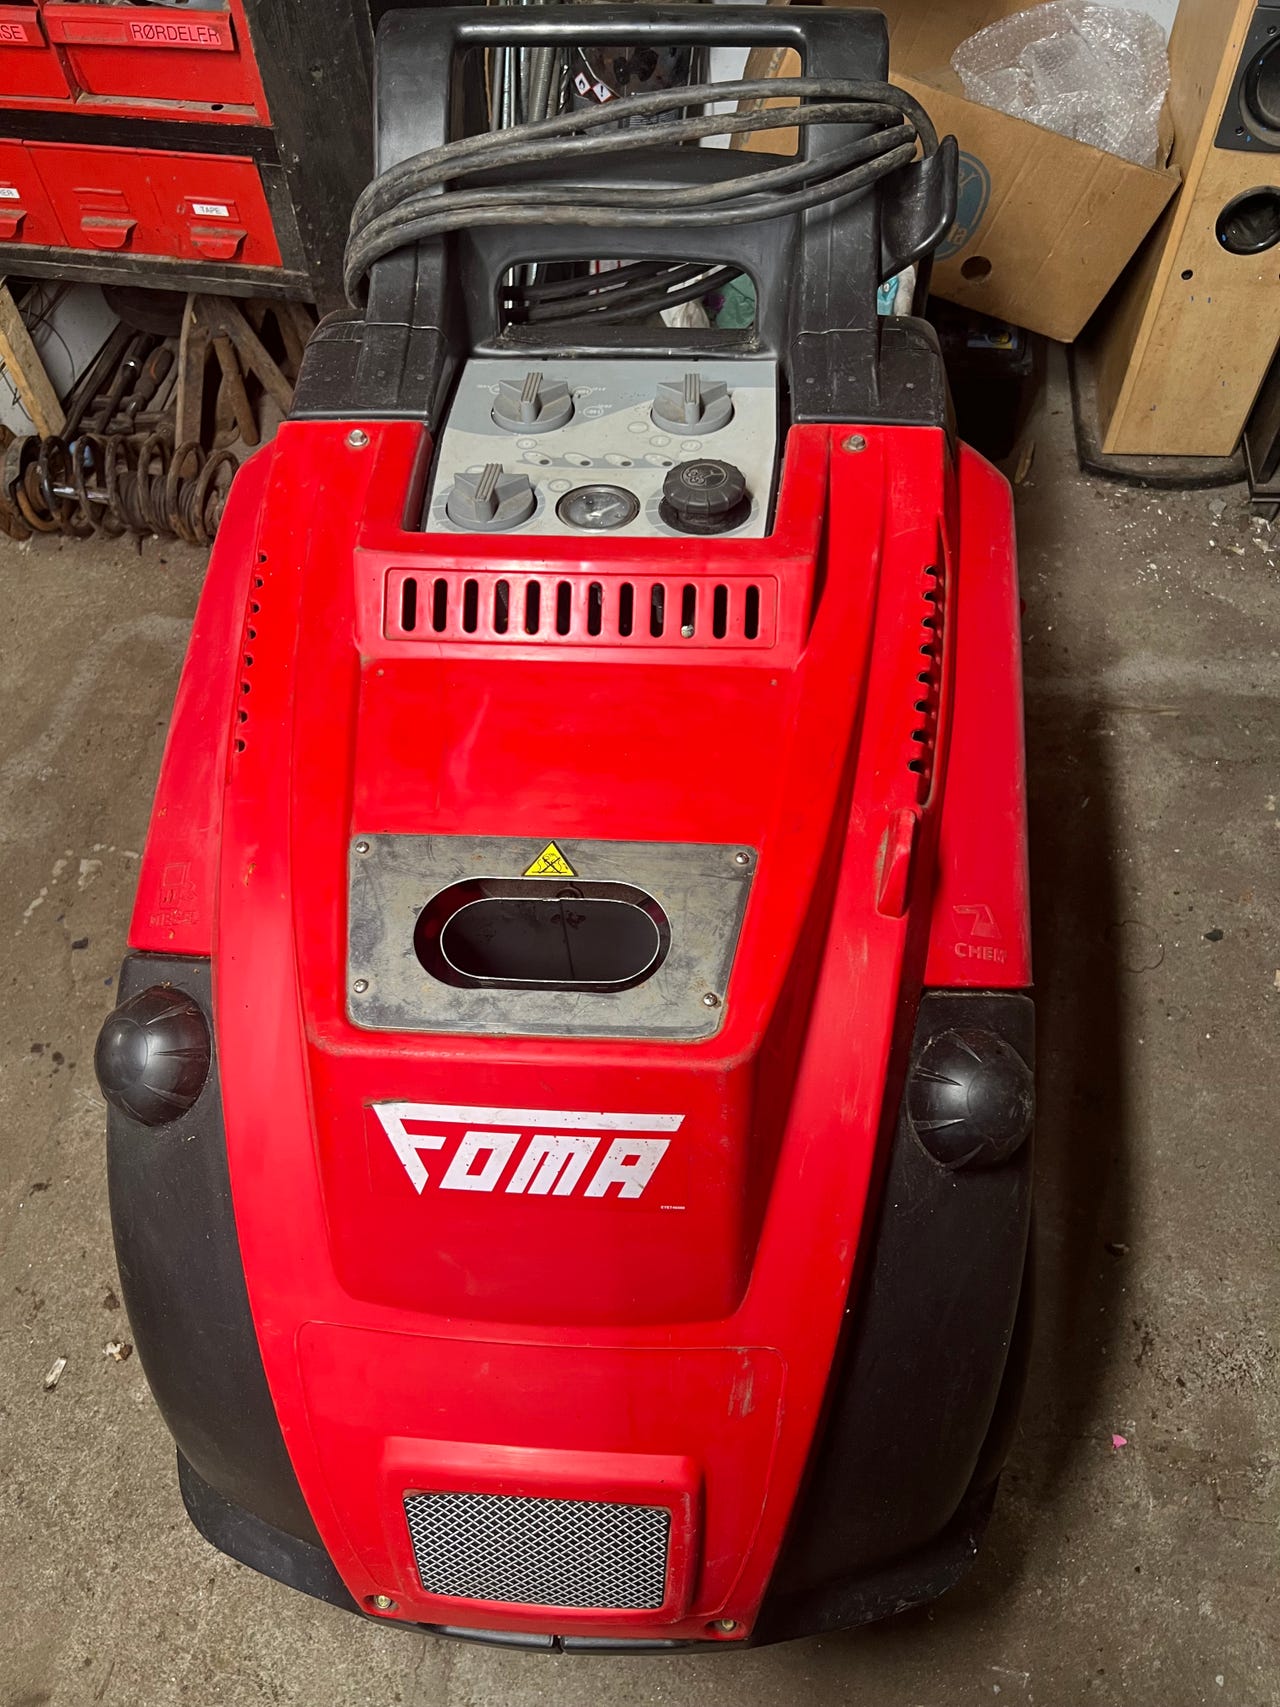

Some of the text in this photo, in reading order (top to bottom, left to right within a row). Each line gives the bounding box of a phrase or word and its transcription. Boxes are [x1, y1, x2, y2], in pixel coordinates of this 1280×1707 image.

[0, 25, 23, 40] SE
[131, 24, 219, 43] RØRDELER
[372, 1102, 686, 1199] FOMA
